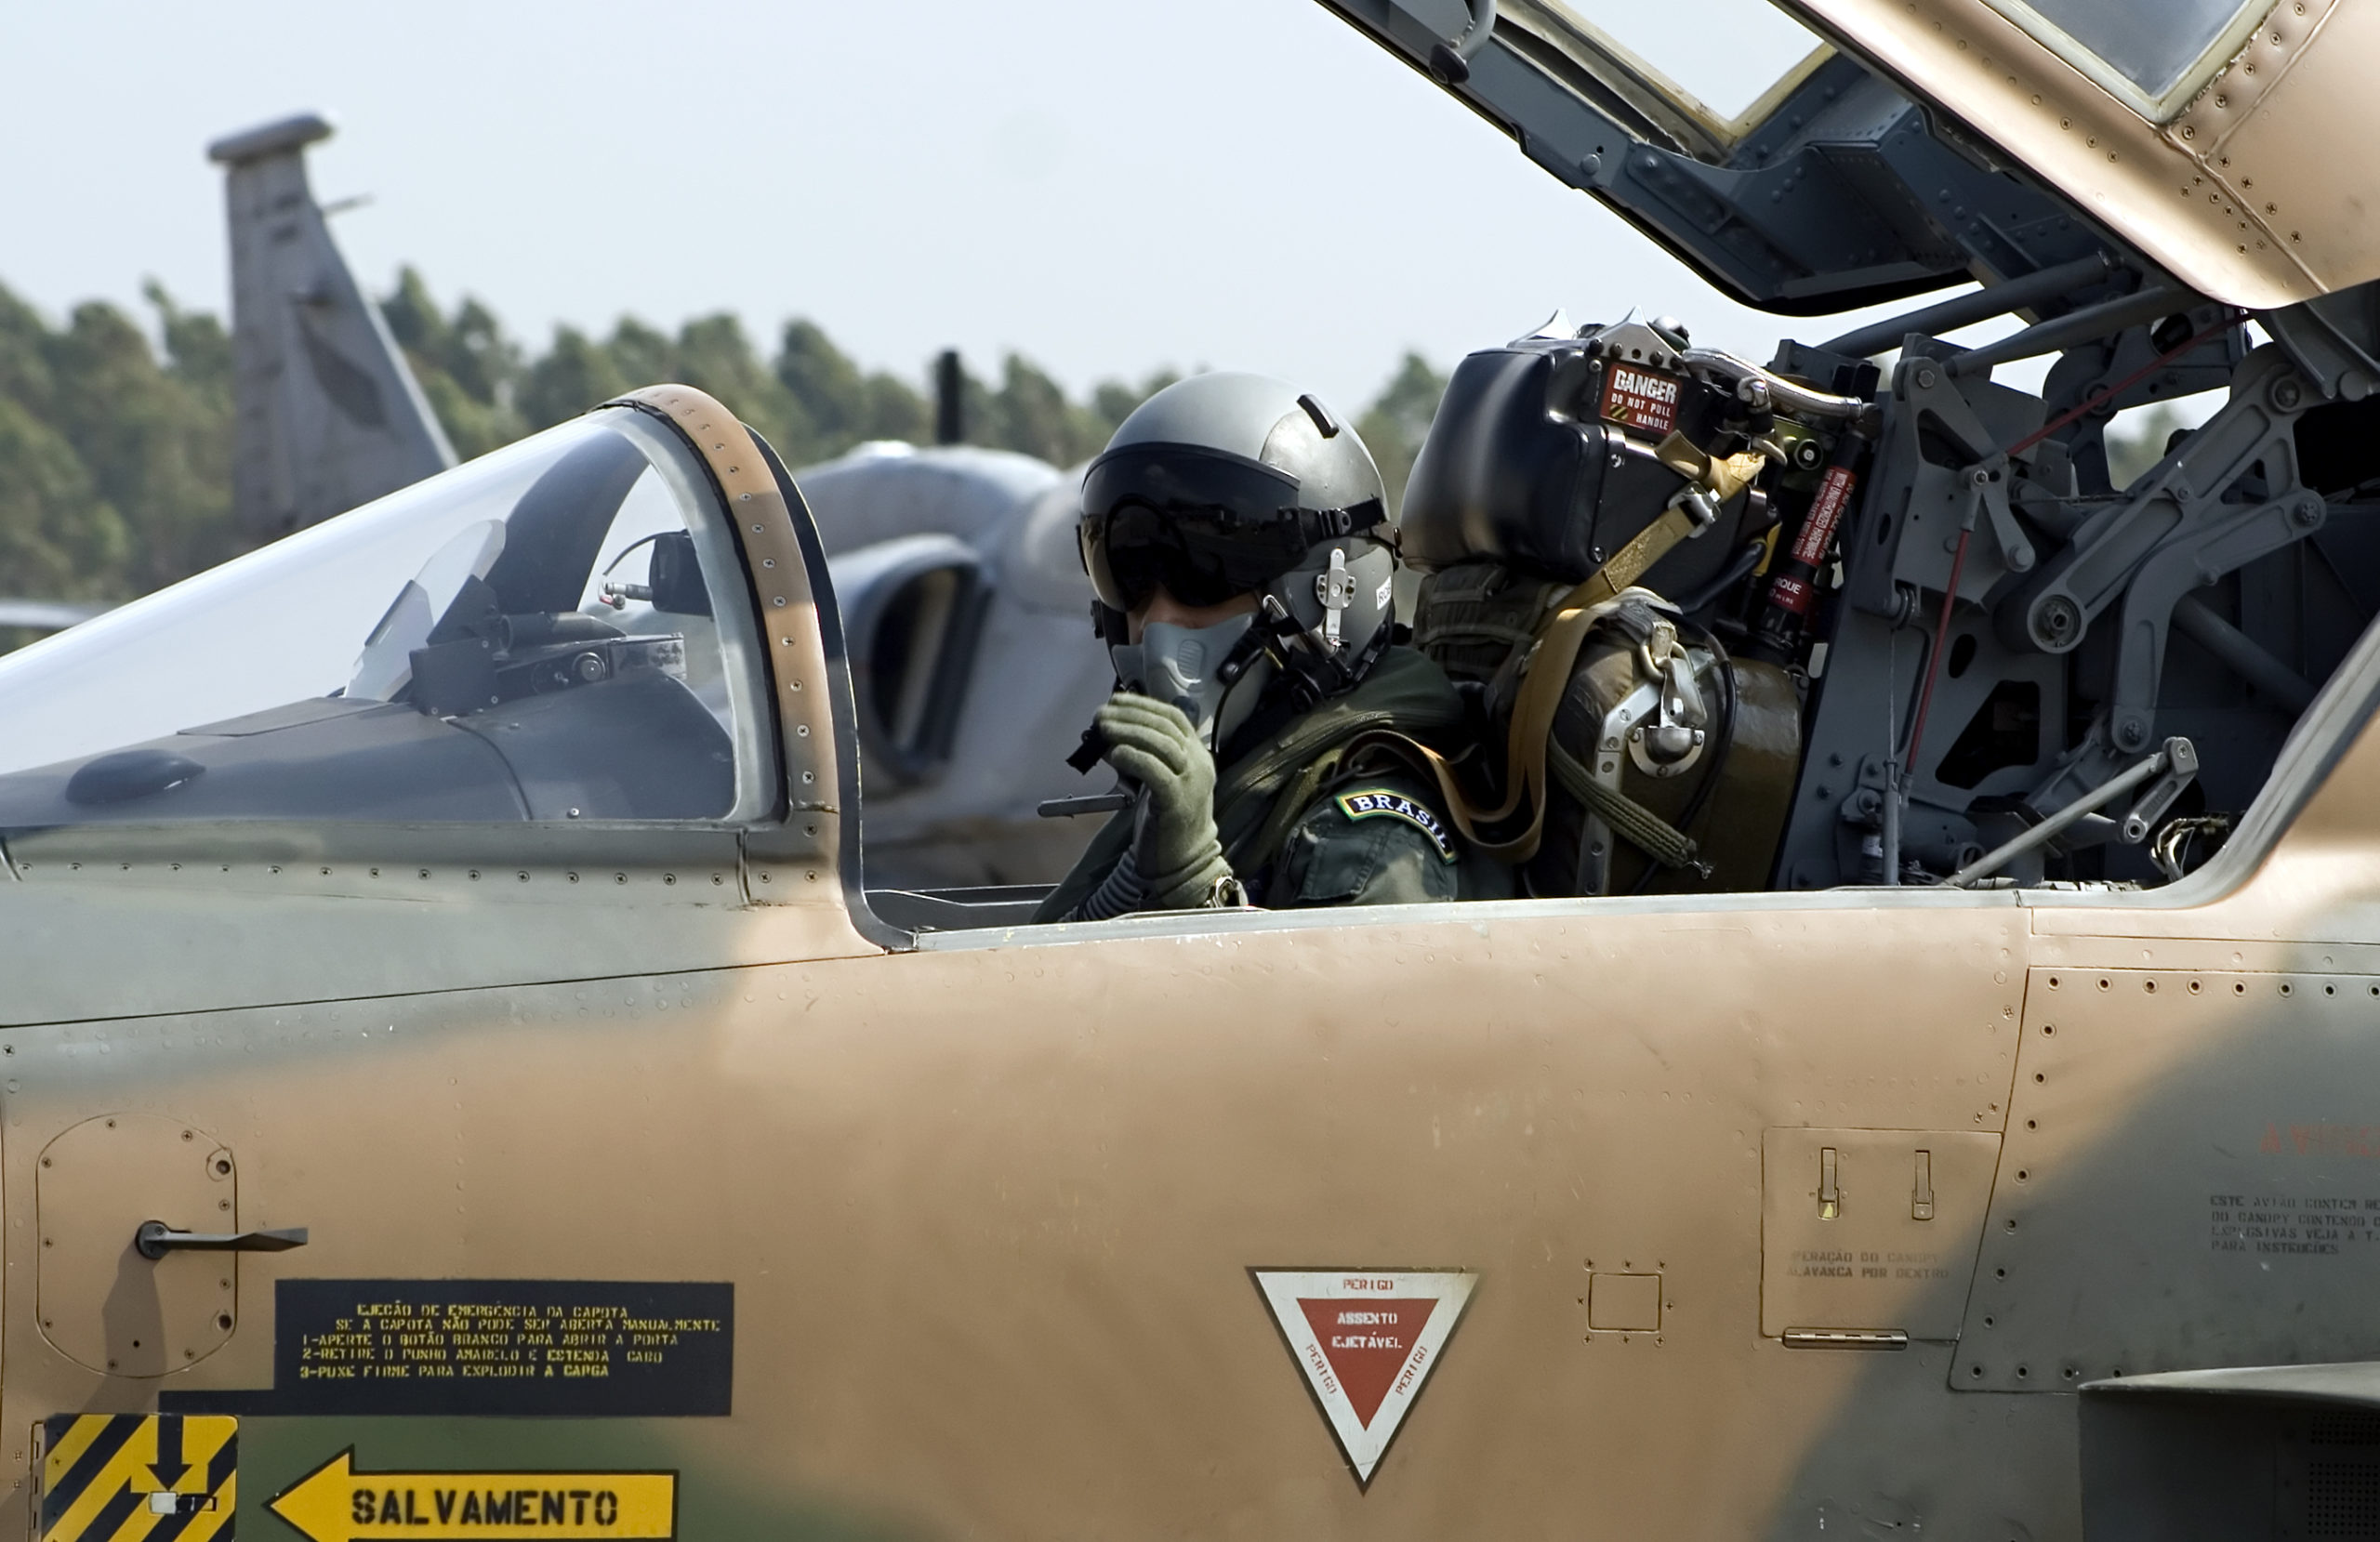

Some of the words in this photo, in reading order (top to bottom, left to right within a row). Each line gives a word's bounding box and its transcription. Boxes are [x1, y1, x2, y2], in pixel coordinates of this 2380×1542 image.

[1613, 369, 1677, 404] DANGER
[1611, 392, 1623, 404] DO
[1627, 397, 1646, 410] NOT
[1650, 403, 1670, 417] PULL
[1636, 414, 1669, 429] HANDLE
[1354, 795, 1446, 848] BRASIL
[2210, 1195, 2244, 1206] ESTE
[2212, 1212, 2228, 1222] DO
[2239, 1212, 2290, 1224] CANOPY
[2298, 1214, 2365, 1227] CONTENDO
[2306, 1229, 2338, 1240] VEJA
[2348, 1230, 2355, 1241] A
[2212, 1241, 2246, 1252] PARA
[1860, 1252, 1878, 1262] DO
[1861, 1268, 1887, 1278] POR
[1896, 1268, 1949, 1279] DENTRO
[1343, 1279, 1394, 1290] PERIGO
[421, 1305, 440, 1316] DE
[548, 1306, 562, 1317] DA
[574, 1307, 628, 1318] CAPOTA
[1337, 1311, 1397, 1325] ASSENTO
[336, 1319, 352, 1330] SE
[364, 1319, 371, 1330] A
[380, 1319, 432, 1331] CAPOTA
[443, 1316, 469, 1331] NÃO
[478, 1319, 514, 1331] PODE
[524, 1319, 549, 1330] SER
[560, 1319, 613, 1331] ABERTA
[623, 1319, 721, 1331] MANUALMENTE
[303, 1334, 372, 1346] 1-APERTE
[382, 1334, 391, 1346] O
[400, 1331, 444, 1346] BOTÃO
[454, 1334, 508, 1346] BRANCO
[517, 1334, 553, 1346] PARA
[562, 1334, 606, 1346] ABRIR
[615, 1334, 623, 1346] A
[633, 1334, 678, 1346] PORTA
[1332, 1331, 1402, 1349] EJETÁVEL
[302, 1348, 375, 1360] 2-RETIRE
[403, 1349, 446, 1361] PUNHO
[456, 1349, 519, 1361] AMARELO
[529, 1350, 536, 1361] E
[547, 1350, 609, 1362] ESTENDA
[628, 1351, 662, 1363] CABO
[300, 1365, 355, 1378] 3-PUXE
[364, 1365, 410, 1377] FIRME
[419, 1365, 454, 1377] PARA
[463, 1365, 535, 1377] EXPLODIR
[545, 1365, 553, 1377] A
[563, 1364, 609, 1377] CARGA
[1306, 1343, 1337, 1395] PERIGO
[1395, 1346, 1427, 1395] PERIGO
[352, 1489, 617, 1525] SALVAMENTO
